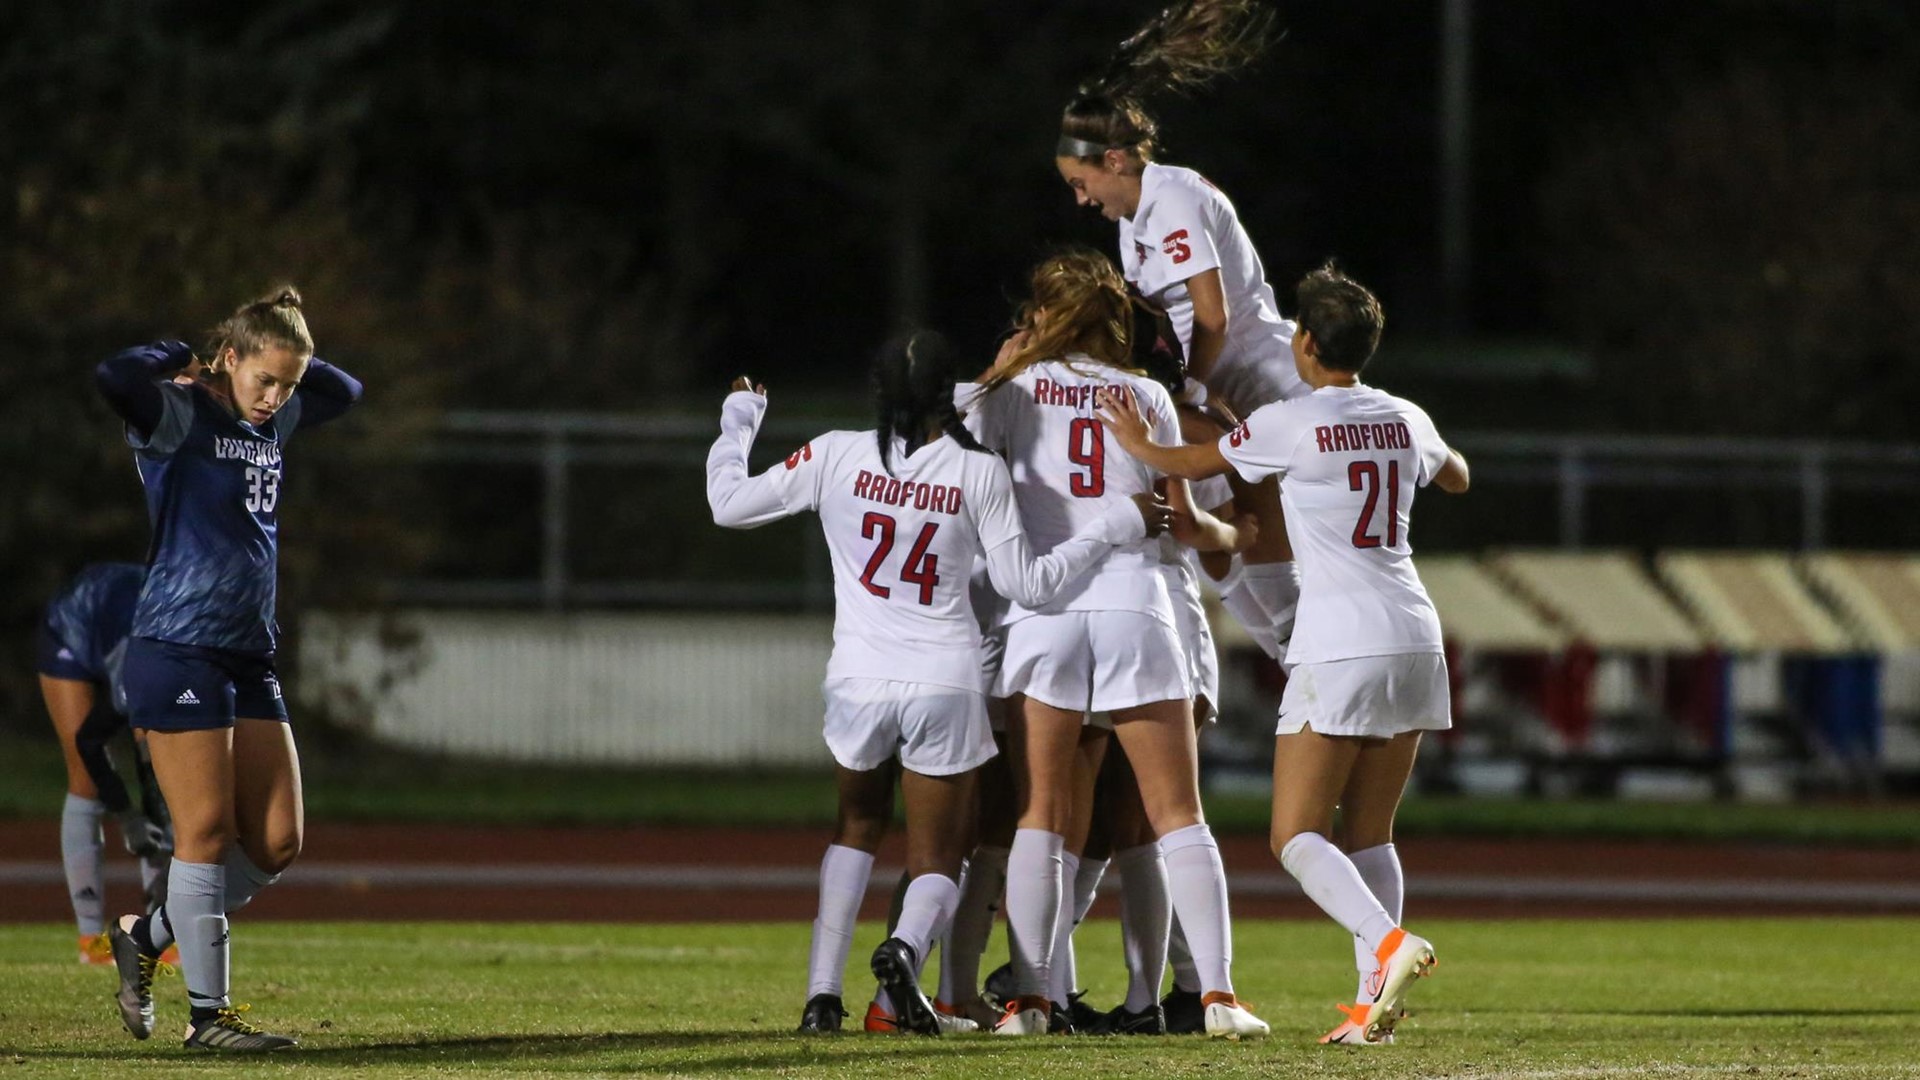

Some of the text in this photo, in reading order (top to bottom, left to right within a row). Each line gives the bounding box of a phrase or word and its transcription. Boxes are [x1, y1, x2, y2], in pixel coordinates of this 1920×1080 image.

[1068, 417, 1105, 498] 9
[1315, 422, 1410, 452] RADFORD
[245, 466, 281, 512] 33
[853, 470, 962, 515] RADFORD
[1348, 460, 1398, 548] 21
[859, 511, 940, 606] 24
